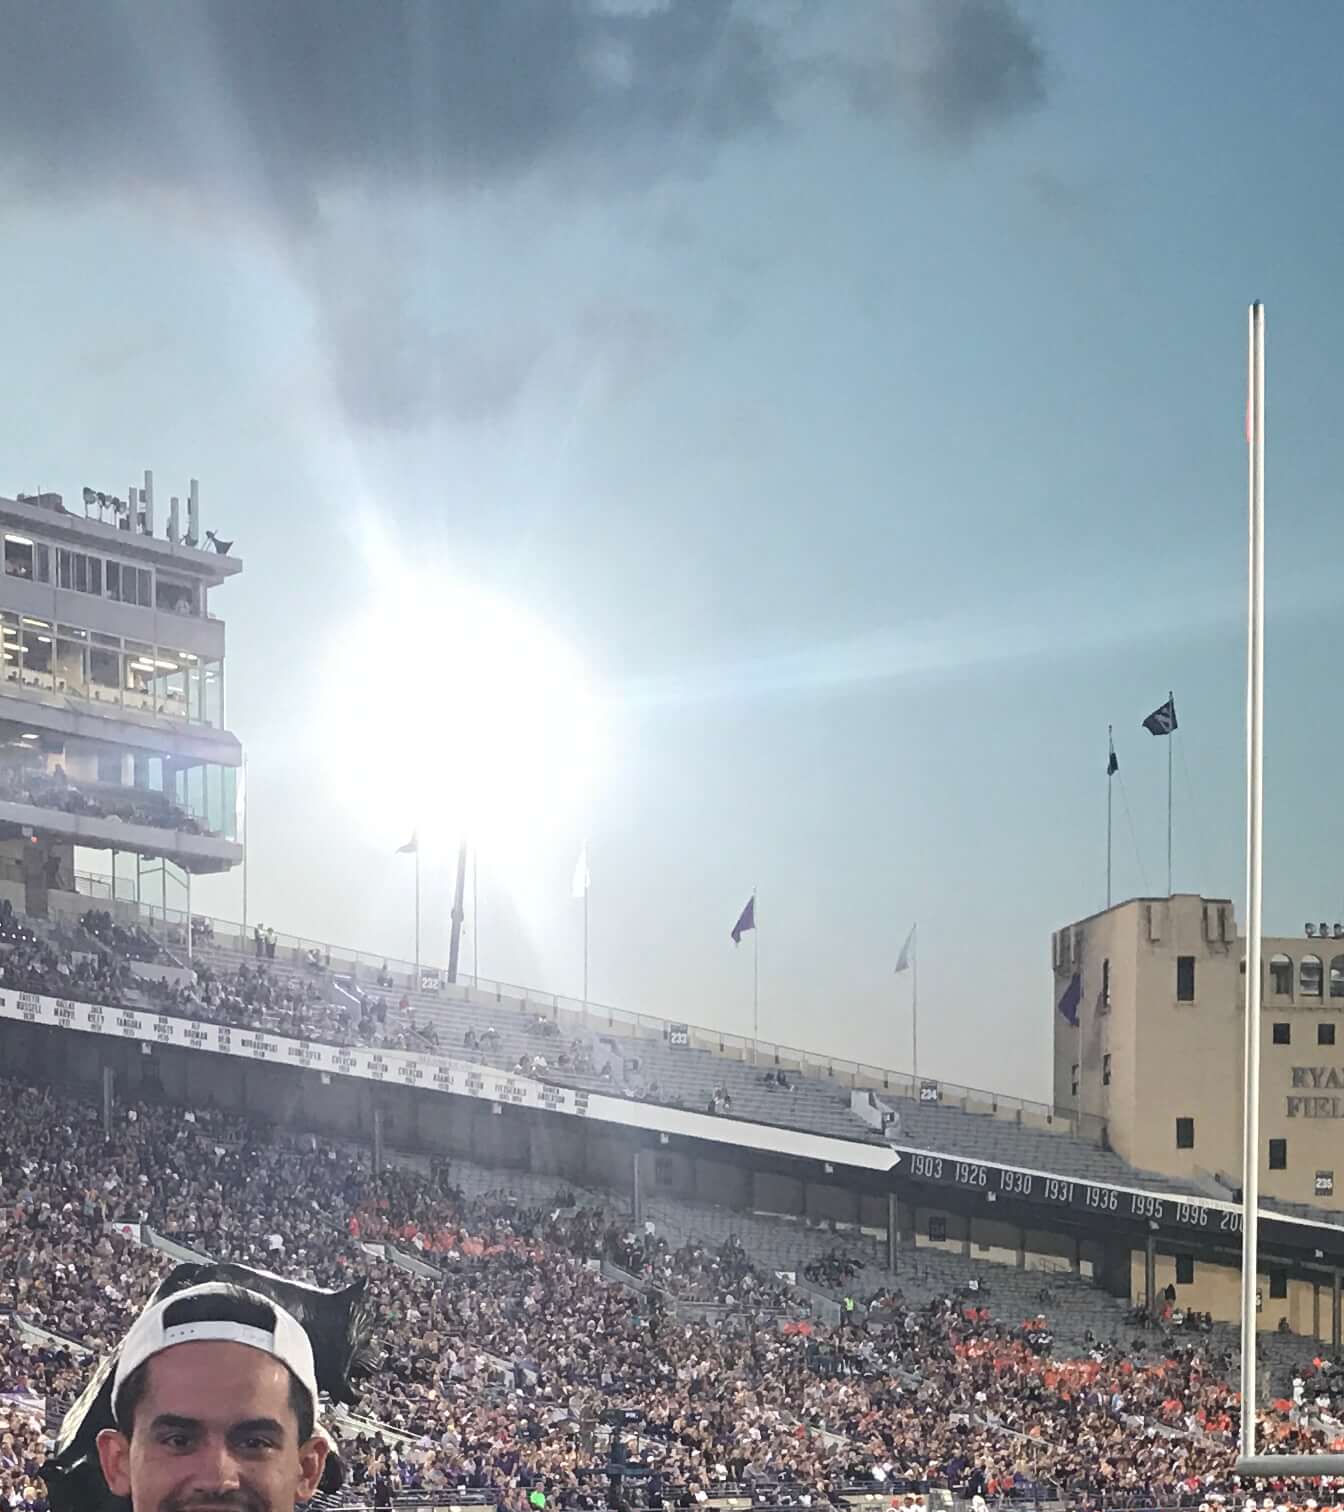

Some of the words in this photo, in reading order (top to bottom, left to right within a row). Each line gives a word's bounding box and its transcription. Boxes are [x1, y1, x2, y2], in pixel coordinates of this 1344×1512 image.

[910, 1155, 944, 1179] 1903
[955, 1162, 987, 1186] 1926
[1000, 1170, 1032, 1195] 1930
[1044, 1179, 1074, 1203] 1931
[1086, 1186, 1119, 1210] 1936
[1131, 1195, 1163, 1218] 1995
[1176, 1202, 1208, 1226] 1996
